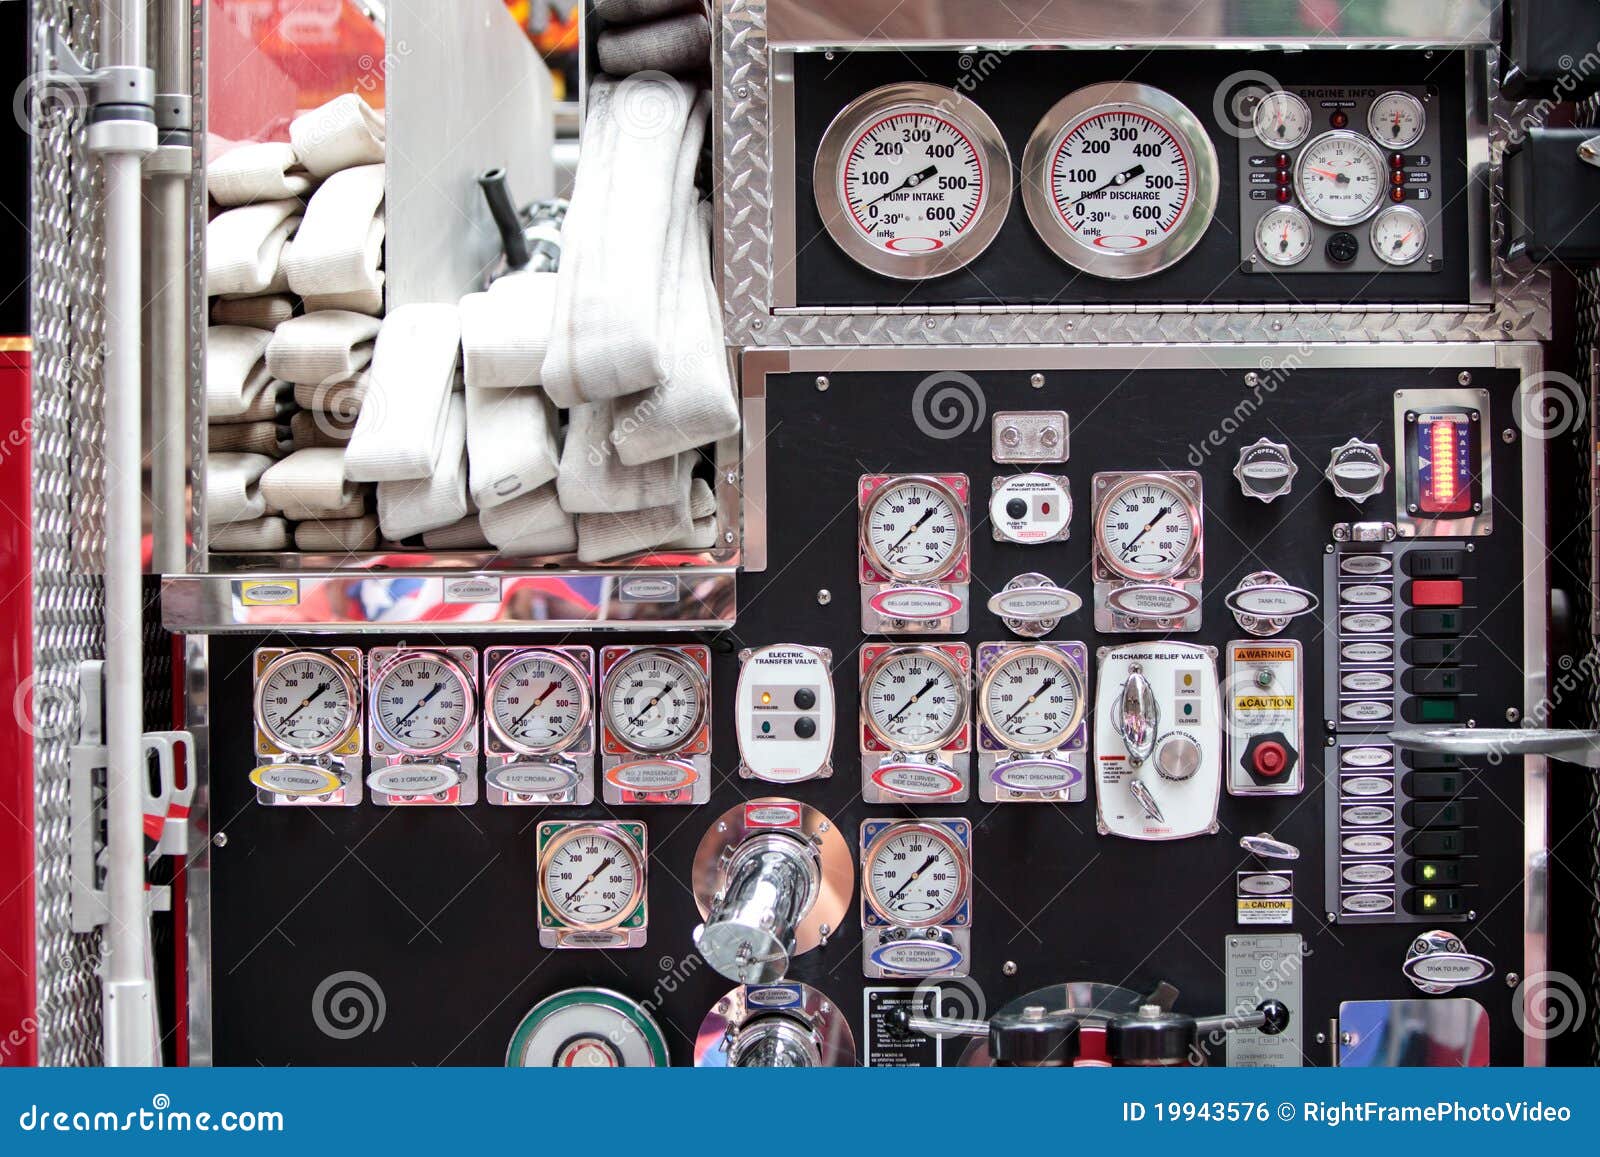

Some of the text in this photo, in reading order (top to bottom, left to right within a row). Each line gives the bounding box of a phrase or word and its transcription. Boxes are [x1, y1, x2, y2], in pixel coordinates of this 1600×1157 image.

[1300, 89, 1377, 98] ENGINE INFO
[902, 129, 931, 143] 300
[1109, 128, 1138, 142] 300
[874, 142, 903, 156] 200
[925, 144, 954, 158] 400
[1081, 140, 1110, 154] 200
[1132, 143, 1162, 157] 400
[861, 171, 889, 185] 100
[1068, 169, 1097, 183] 100
[938, 176, 967, 190] 500
[1145, 175, 1174, 189] 500
[883, 192, 945, 202] PUMP INTAKE
[1109, 191, 1161, 200] DISCHARGE
[869, 205, 878, 219] 0
[926, 206, 955, 221] 600
[1076, 204, 1085, 217] 0
[1132, 205, 1162, 220] 600
[876, 228, 895, 239] inHg
[939, 228, 951, 238] psi
[1083, 227, 1101, 237] inHg
[1145, 227, 1158, 237] psi
[908, 497, 920, 505] 300
[1160, 542, 1172, 550] 600
[1246, 650, 1292, 658] WARNING
[301, 672, 314, 680] 300
[892, 676, 906, 684] 200
[285, 680, 298, 688] 200
[401, 680, 414, 688] 200
[276, 697, 288, 705] 100
[884, 694, 895, 702] 100
[1246, 698, 1292, 707] CAUTION
[324, 701, 336, 709] 500
[556, 700, 568, 708] 500
[550, 716, 562, 724] 600
[288, 777, 319, 785] CROSSLAY
[907, 780, 940, 788] DISCHARGE
